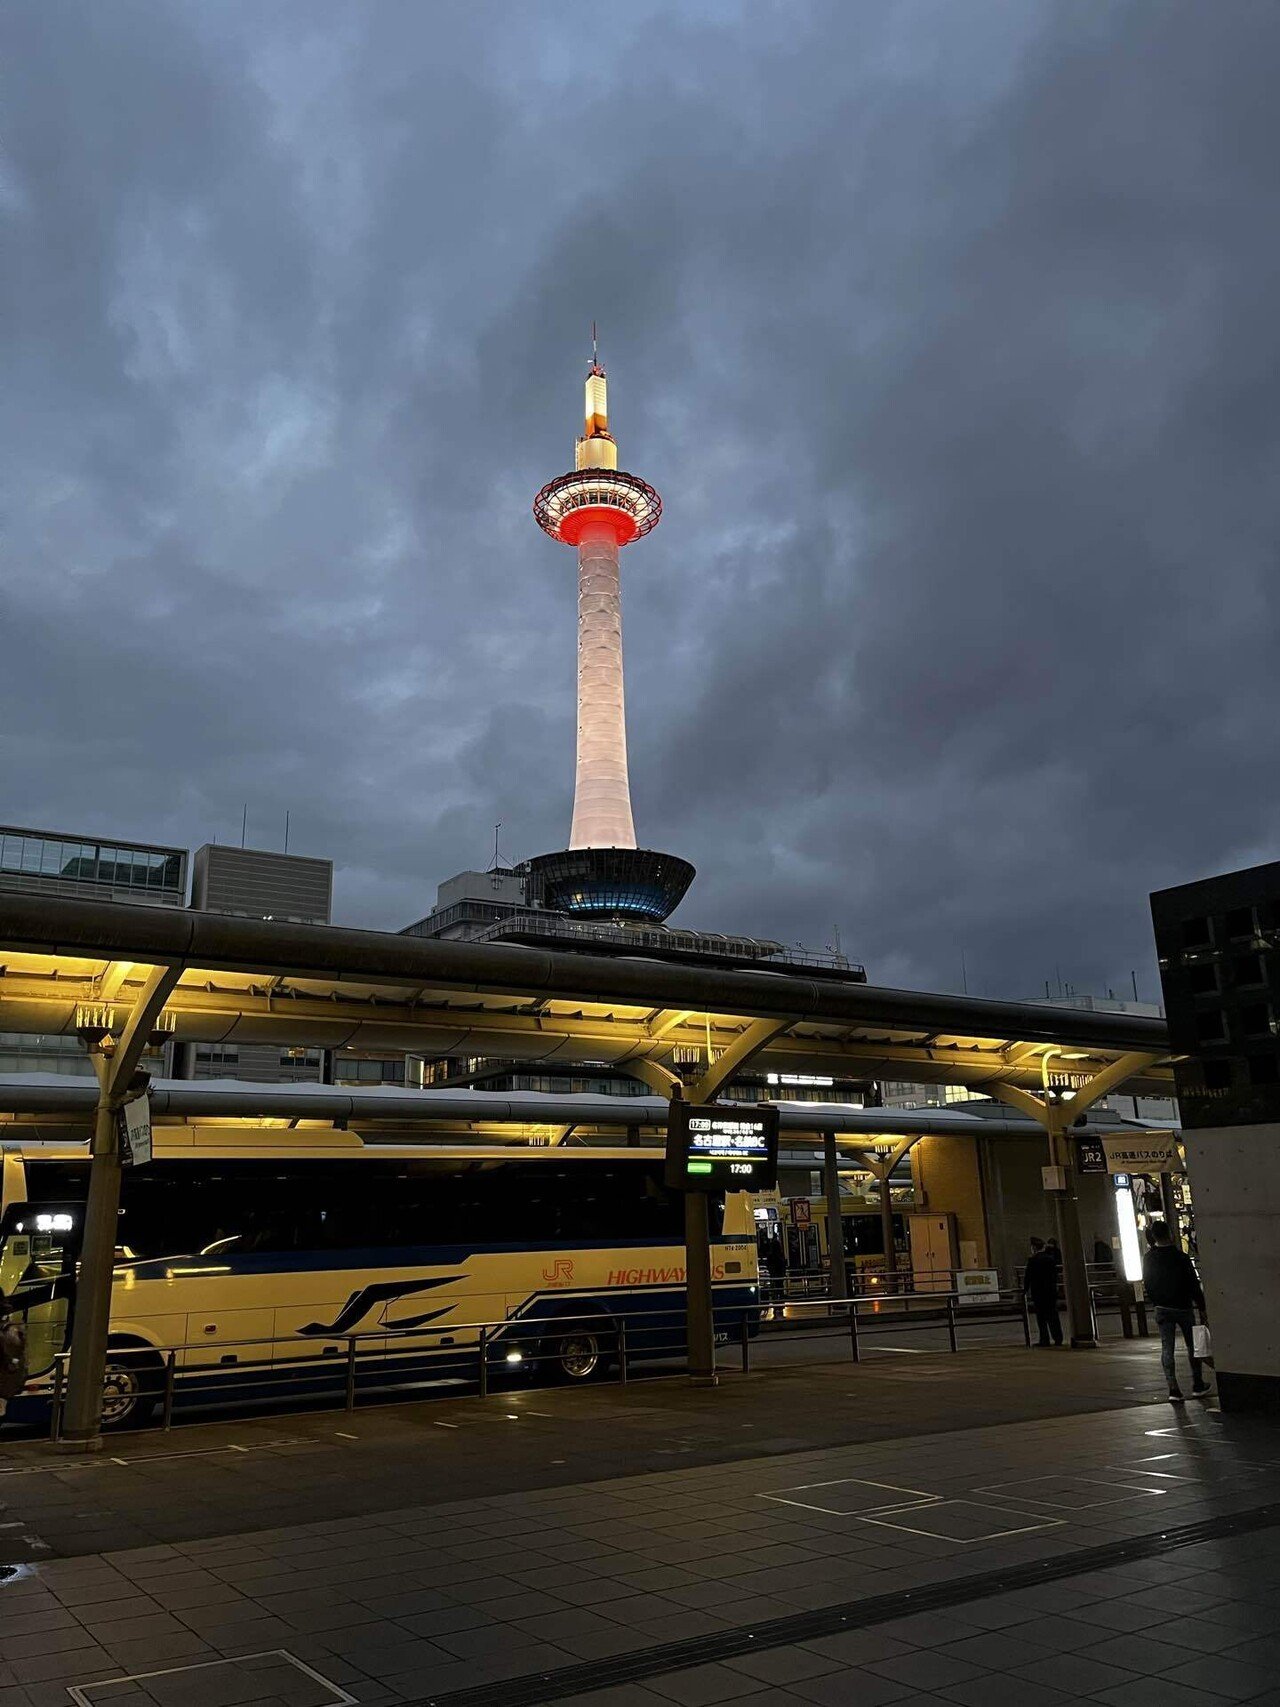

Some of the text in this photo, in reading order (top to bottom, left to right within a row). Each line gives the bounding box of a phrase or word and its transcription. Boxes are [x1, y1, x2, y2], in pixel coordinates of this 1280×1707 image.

[1084, 1151, 1103, 1163] JR2
[730, 1164, 752, 1173] 17:00
[542, 1259, 574, 1281] JR
[607, 1265, 725, 1286] HIGHWAY US
